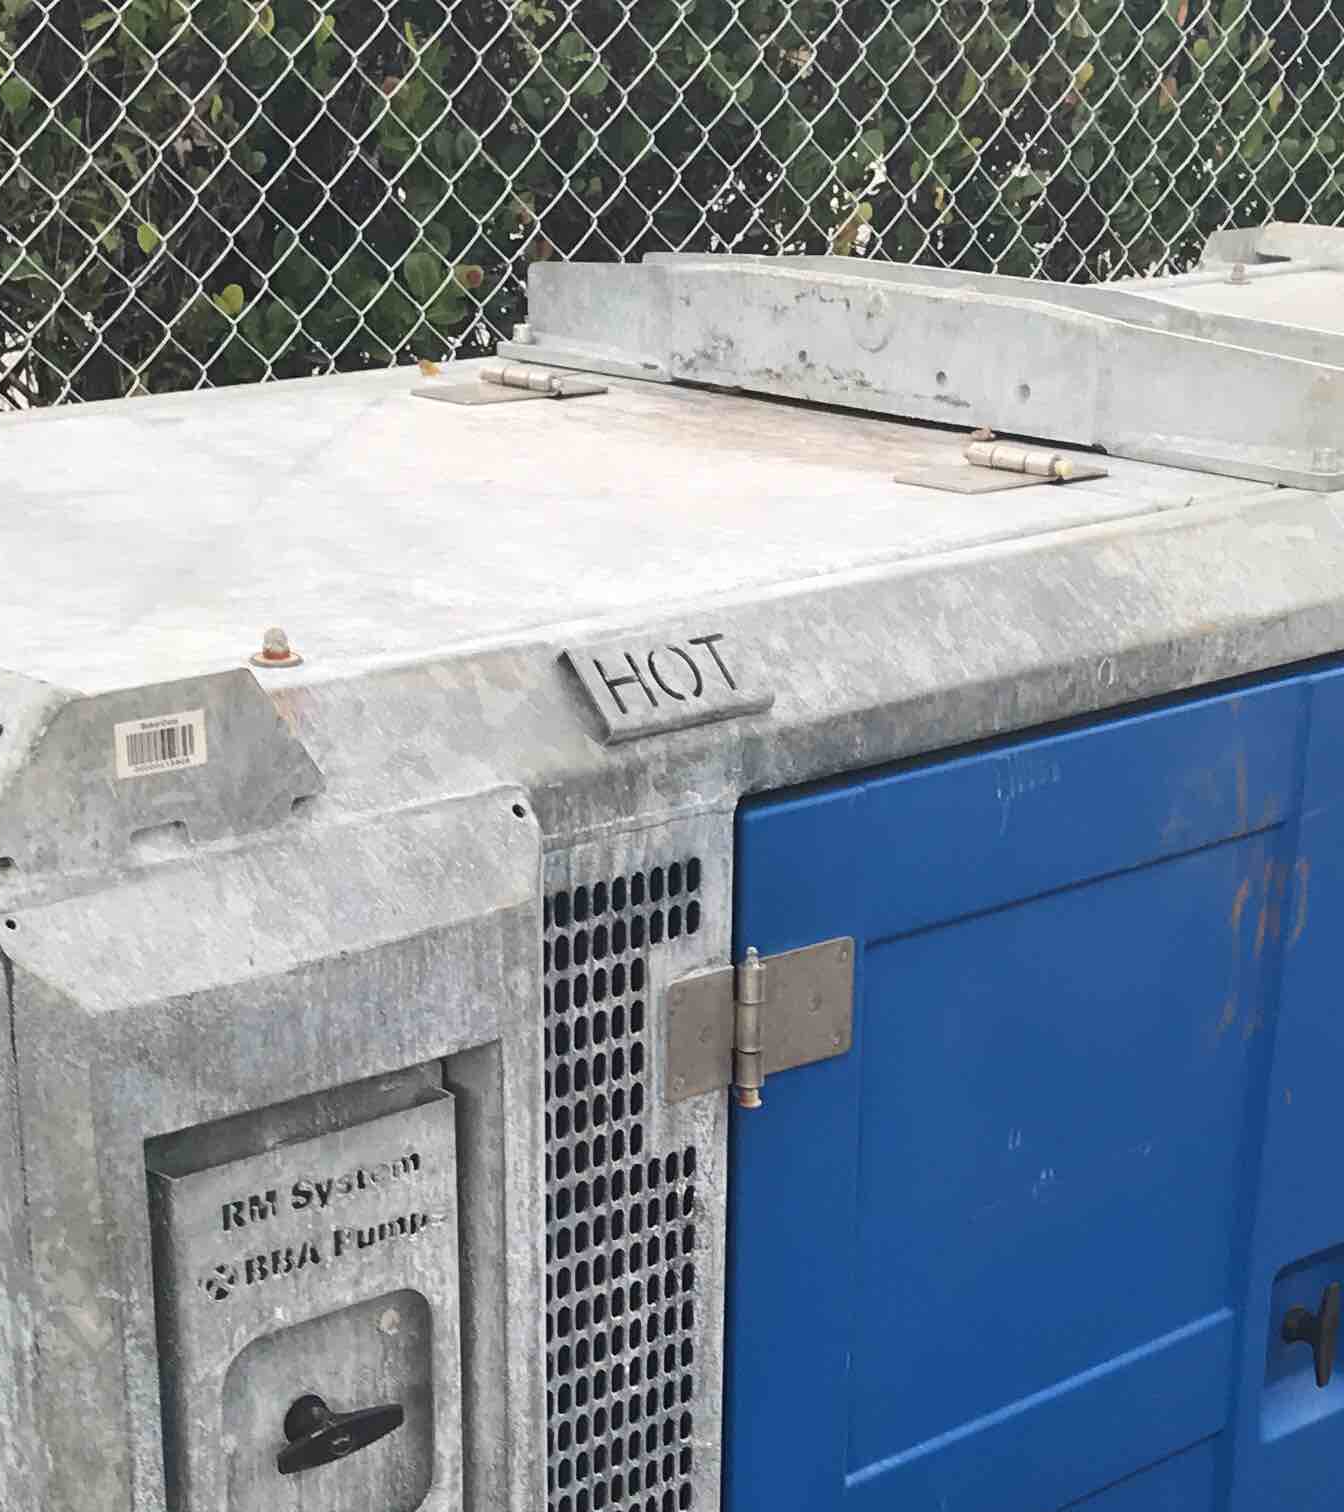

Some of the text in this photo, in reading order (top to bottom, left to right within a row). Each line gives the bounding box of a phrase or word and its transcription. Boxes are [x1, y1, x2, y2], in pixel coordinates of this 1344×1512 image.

[592, 632, 738, 715] HOT
[221, 1151, 421, 1231] RM System
[244, 1241, 321, 1285] BBA
